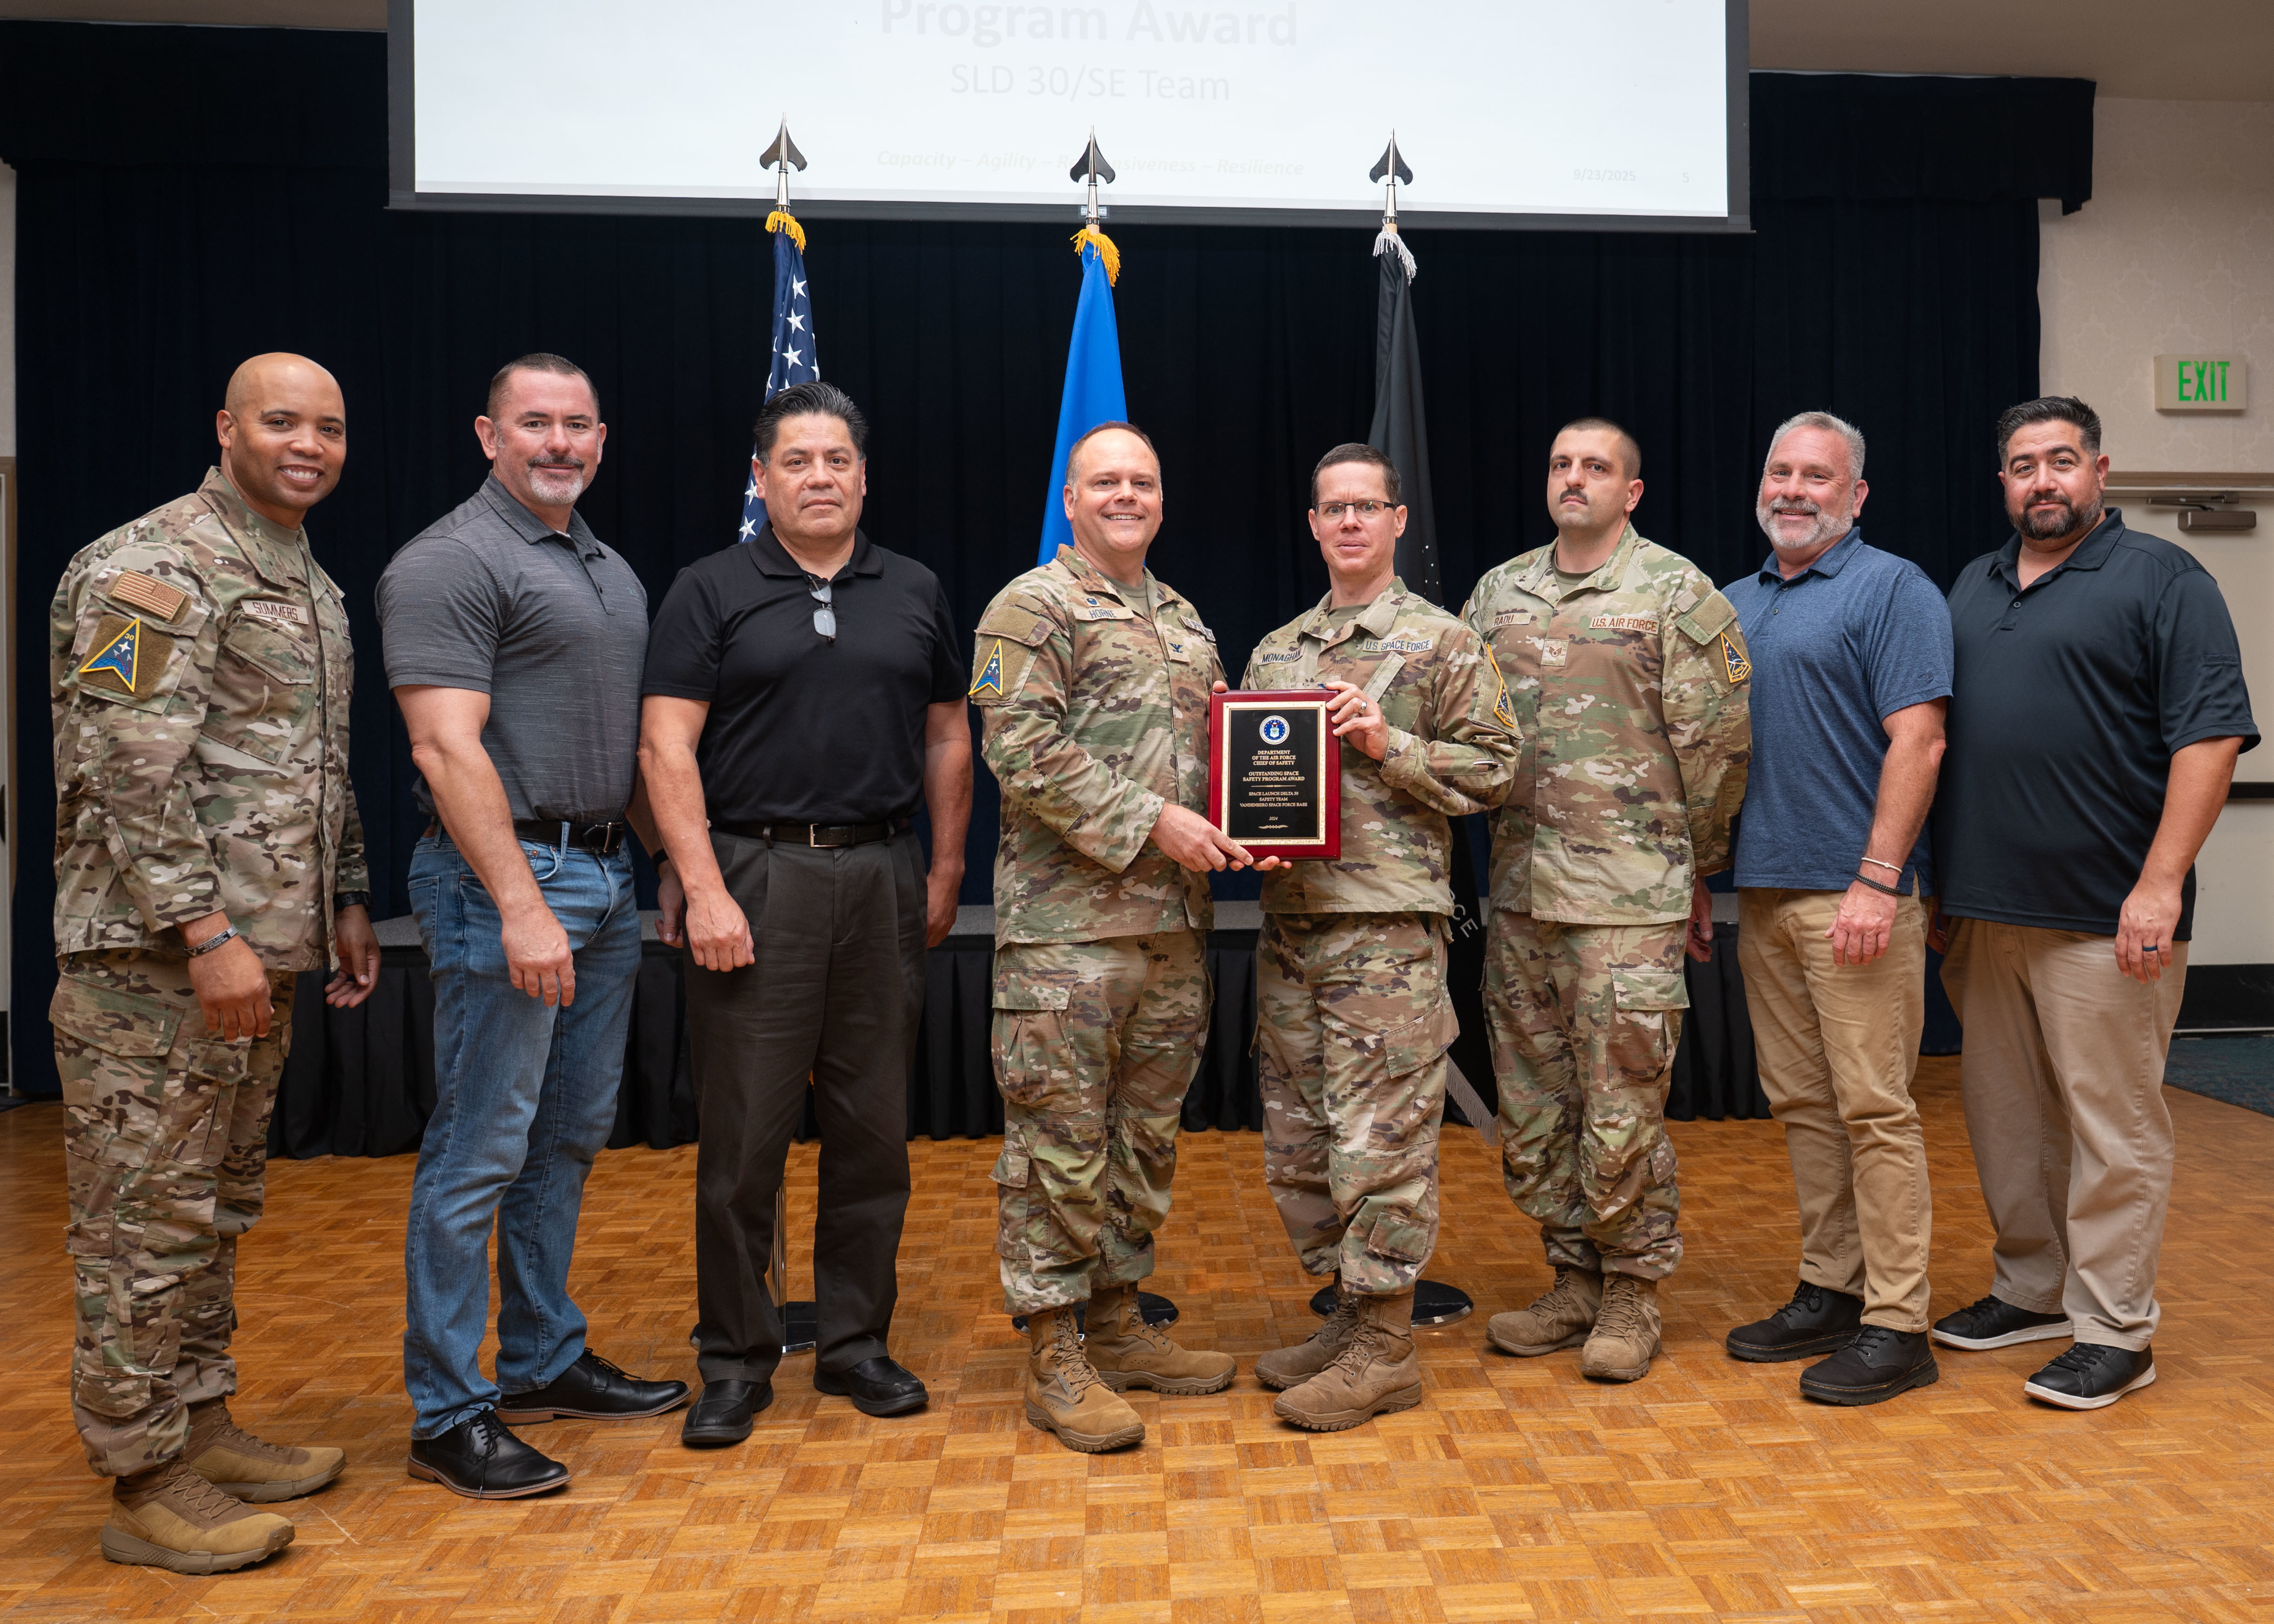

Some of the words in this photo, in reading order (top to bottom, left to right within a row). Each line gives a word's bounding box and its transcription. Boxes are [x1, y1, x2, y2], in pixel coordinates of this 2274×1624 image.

[882, 0, 1107, 48] Program
[1126, 0, 1297, 46] Award
[950, 64, 1014, 94] SLD
[1027, 64, 1127, 102] 30/SE
[1138, 69, 1229, 100] Team
[877, 150, 957, 170] Capacity
[977, 152, 1036, 172] Agility
[1216, 158, 1304, 175] Resilience
[1574, 168, 1636, 182] 9/23/2025
[1682, 172, 1690, 183] 5
[2178, 361, 2230, 402] EXIT
[252, 602, 299, 621] SUMMERS
[1089, 609, 1117, 619] HORNE
[1493, 615, 1514, 626] RADU
[1592, 618, 1606, 627] U.S.
[1608, 618, 1625, 628] AIR
[1627, 618, 1658, 632] FORCE
[1365, 641, 1378, 650] U.S.
[1381, 640, 1405, 651] SPACE
[1406, 640, 1430, 651] FORCE
[1262, 648, 1302, 663] MONAGHAN
